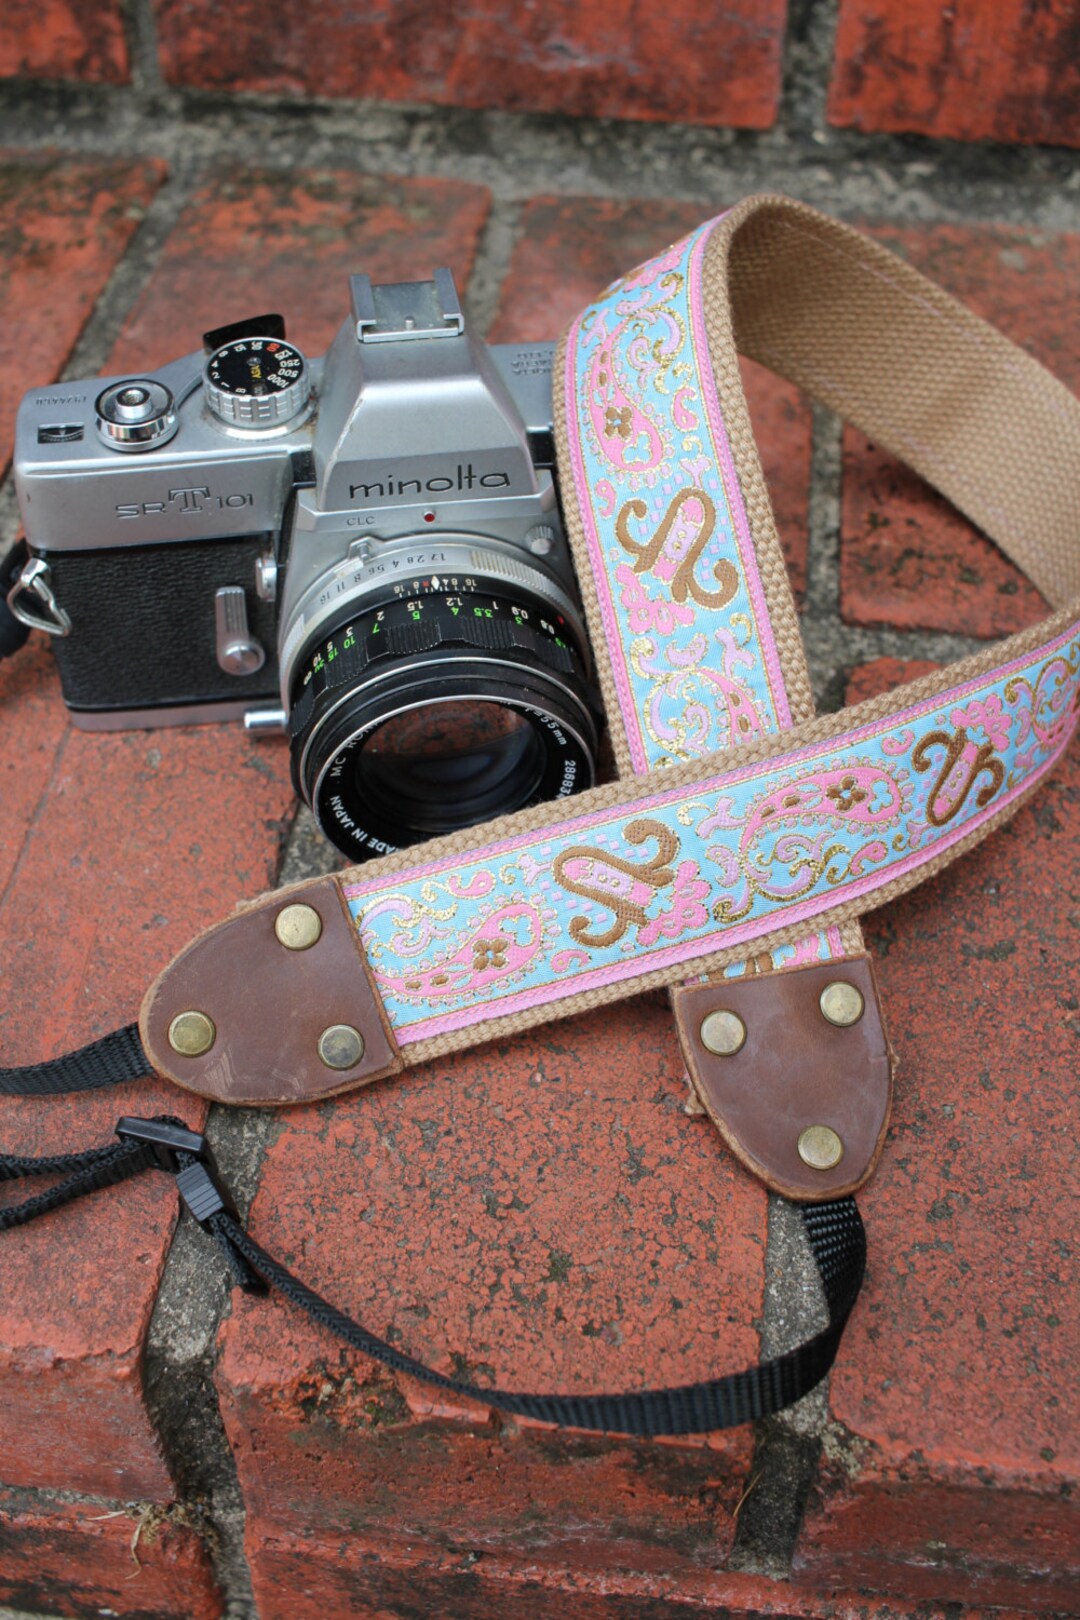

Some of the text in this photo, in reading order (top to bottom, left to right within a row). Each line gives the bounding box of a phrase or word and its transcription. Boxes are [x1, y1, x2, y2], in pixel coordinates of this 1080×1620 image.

[274, 350, 293, 360] 125
[280, 359, 300, 368] 250
[278, 368, 298, 378] 500
[267, 374, 289, 388] 1000
[350, 464, 511, 498] minolta
[346, 516, 375, 526] CLC
[393, 560, 399, 568] 4
[354, 574, 361, 583] 8
[337, 581, 345, 592] 11
[320, 592, 330, 605] 16
[446, 597, 463, 606] 1.2
[407, 601, 424, 611] 1.5
[492, 601, 499, 609] 1
[377, 611, 384, 621] 2
[412, 611, 420, 620] 5
[451, 607, 459, 616] 4
[511, 606, 528, 619] 0.9
[372, 623, 380, 633] 7
[343, 636, 355, 648] 10
[328, 648, 339, 662] 15
[330, 757, 346, 777] MC
[330, 795, 402, 855] ADE IN JAPAN
